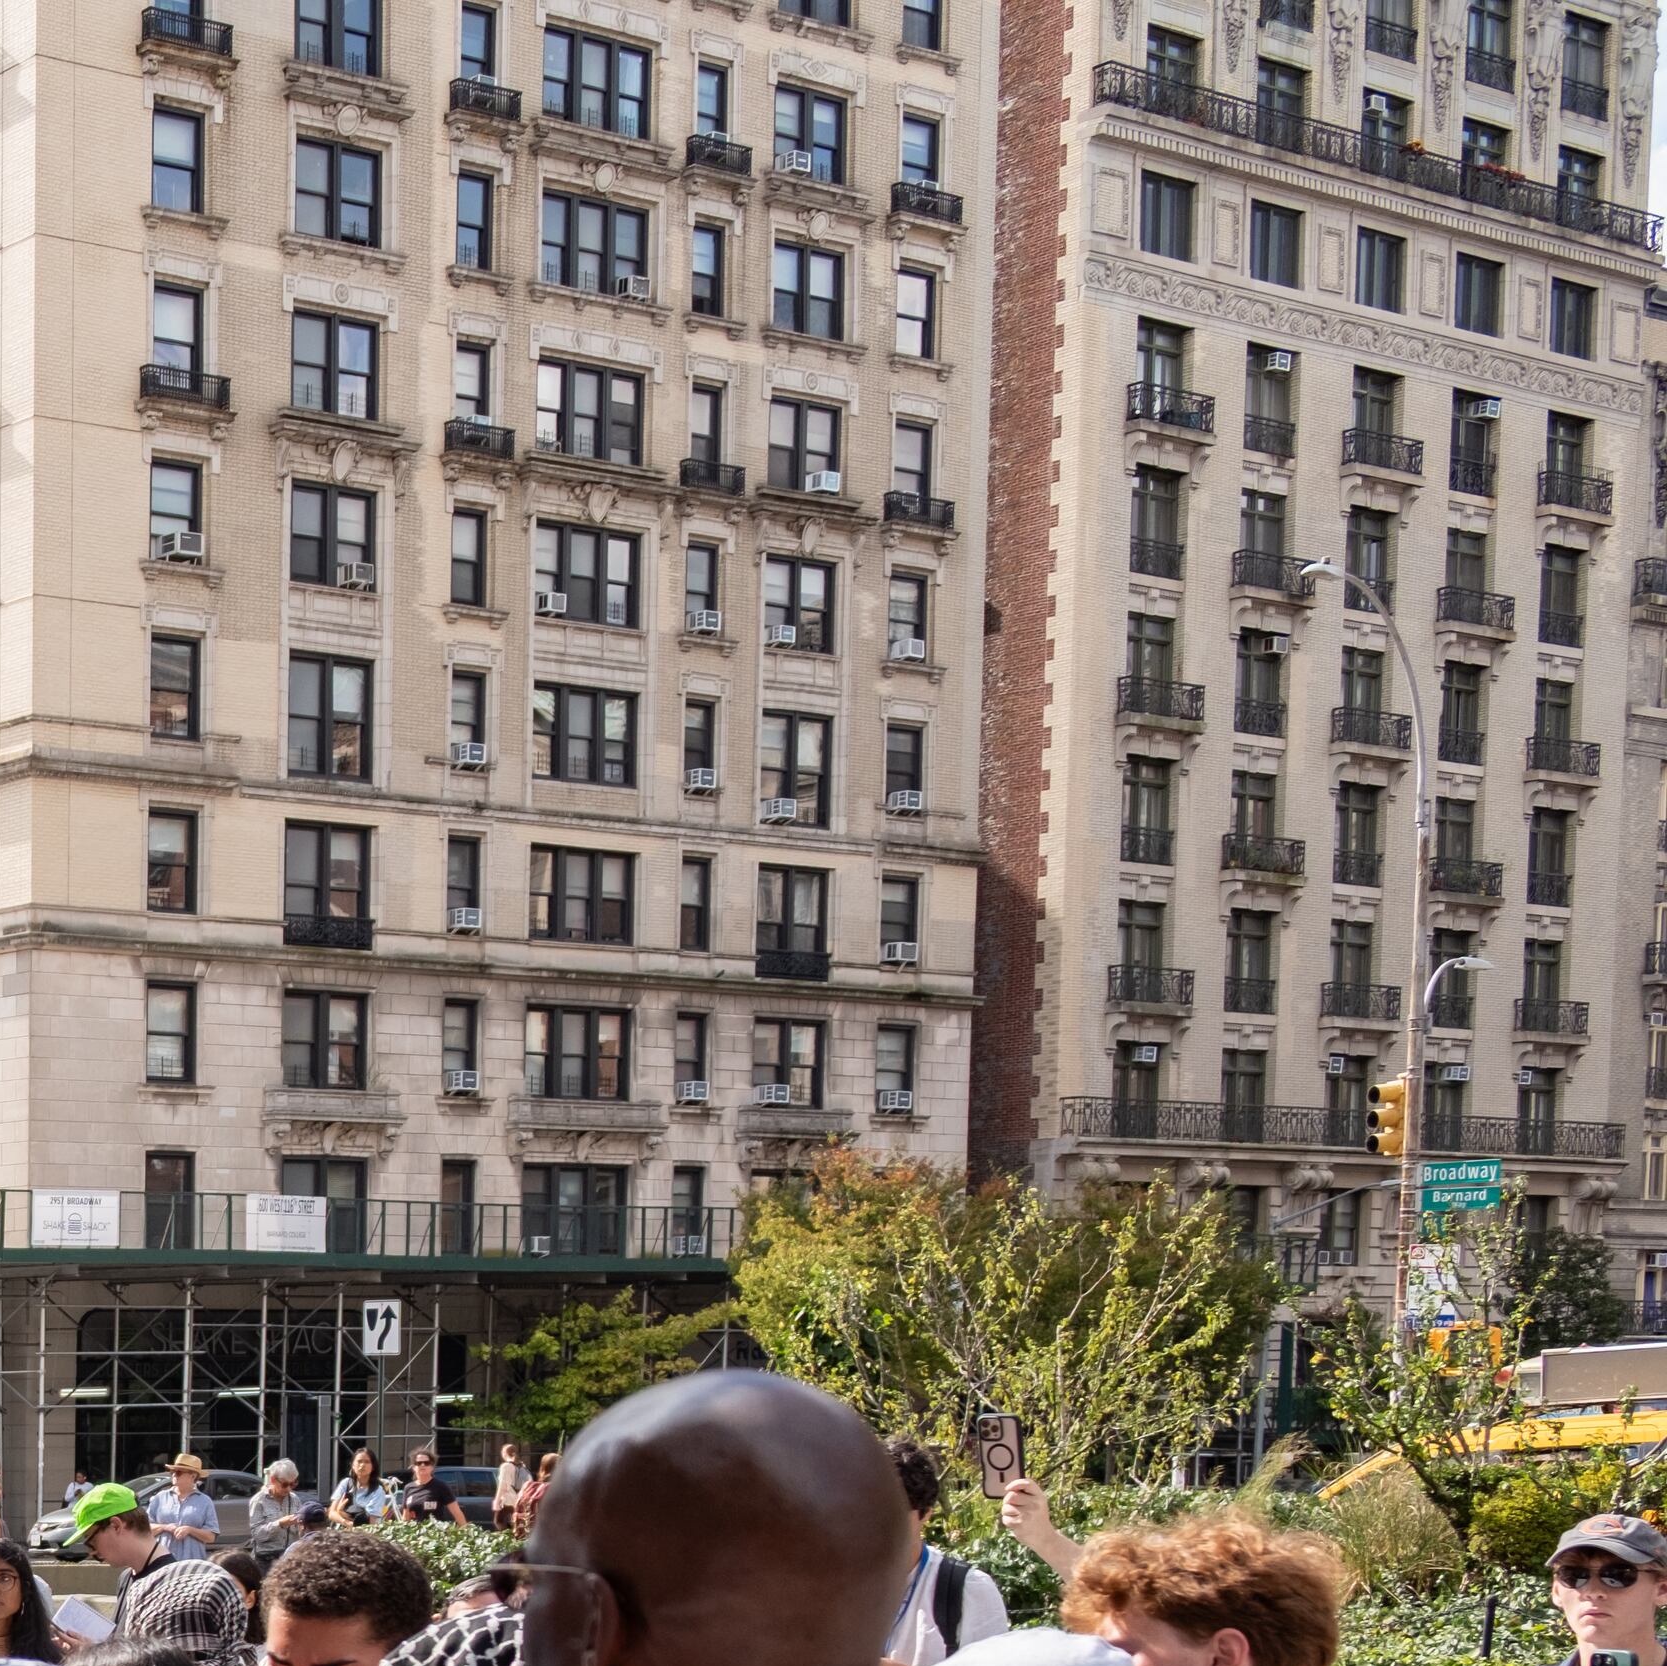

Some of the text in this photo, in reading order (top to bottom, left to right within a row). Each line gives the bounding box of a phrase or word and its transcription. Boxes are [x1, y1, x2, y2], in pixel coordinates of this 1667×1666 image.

[1423, 1163, 1498, 1182] Broadway
[67, 1197, 103, 1205] BROADWAY
[1432, 1189, 1488, 1203] Barnard
